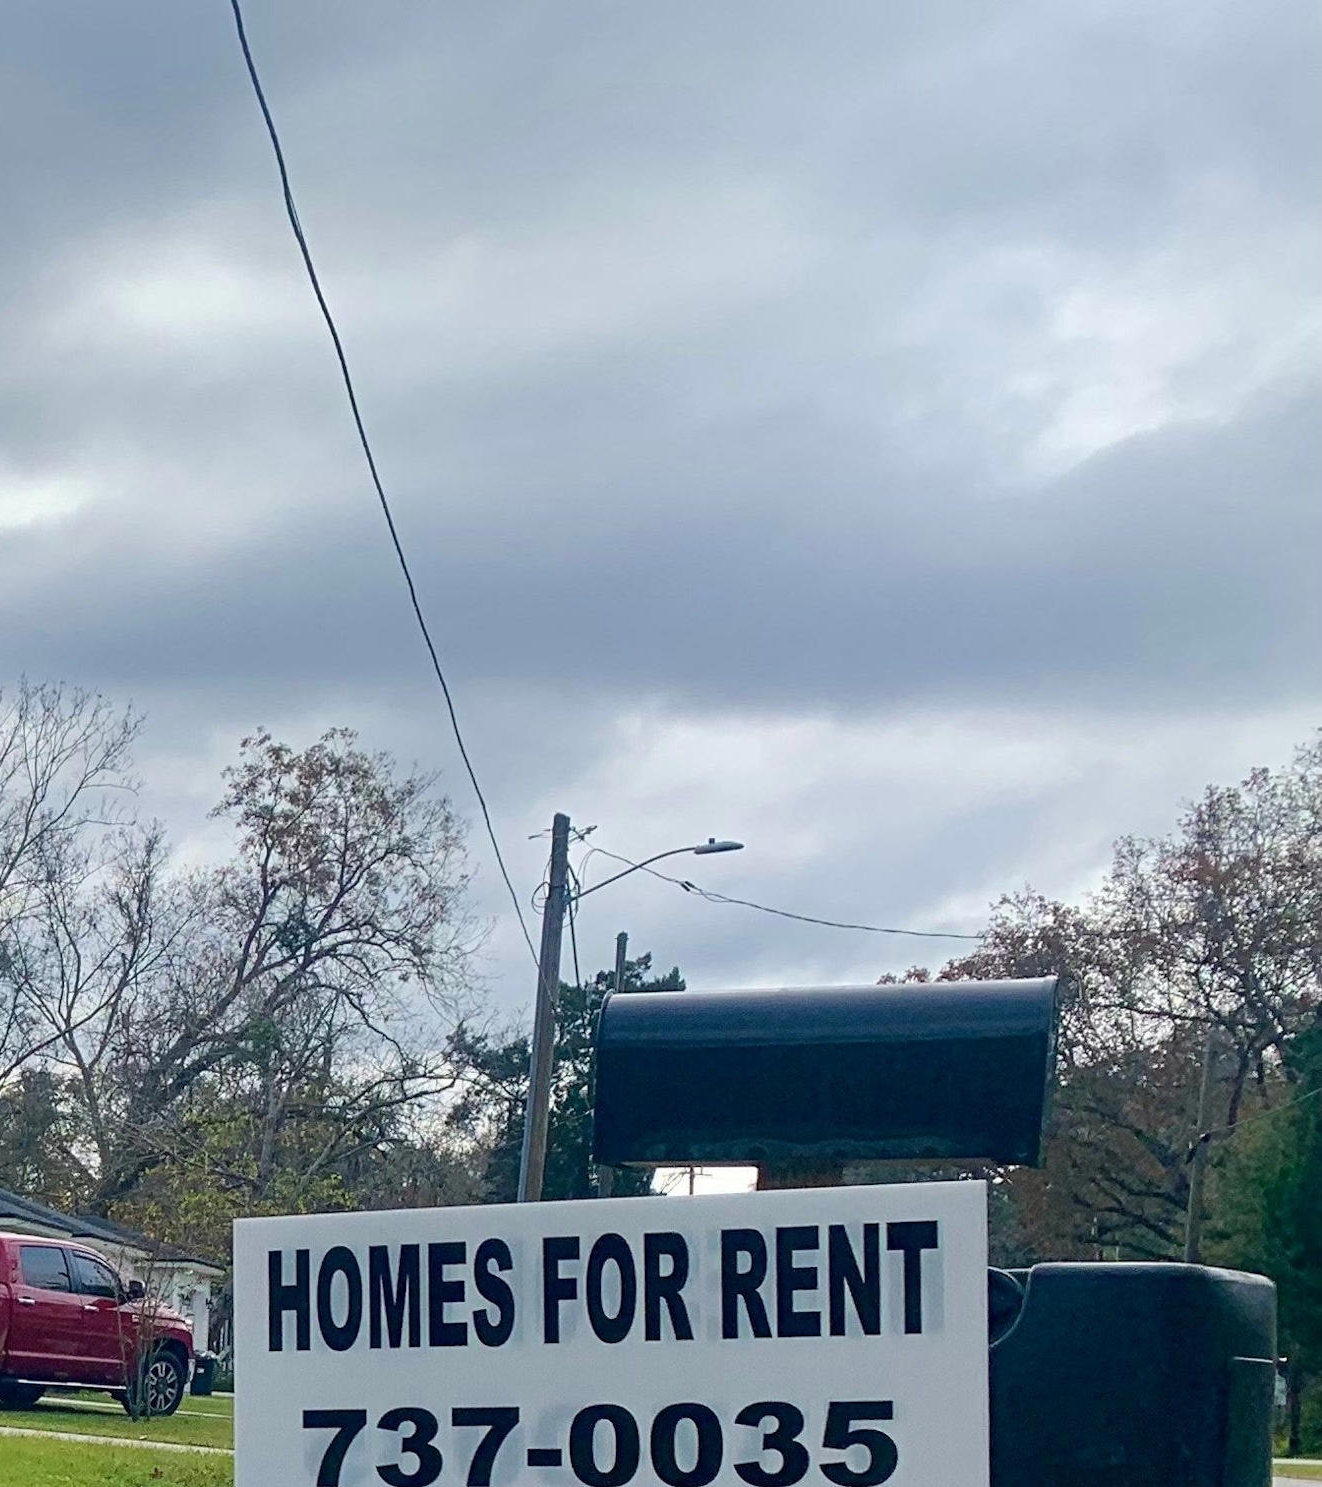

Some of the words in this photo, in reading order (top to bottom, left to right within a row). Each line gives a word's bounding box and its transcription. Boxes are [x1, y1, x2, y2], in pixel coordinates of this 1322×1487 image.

[269, 1239, 515, 1352] HOMES
[543, 1232, 694, 1344] FOR
[721, 1220, 939, 1340] RENT
